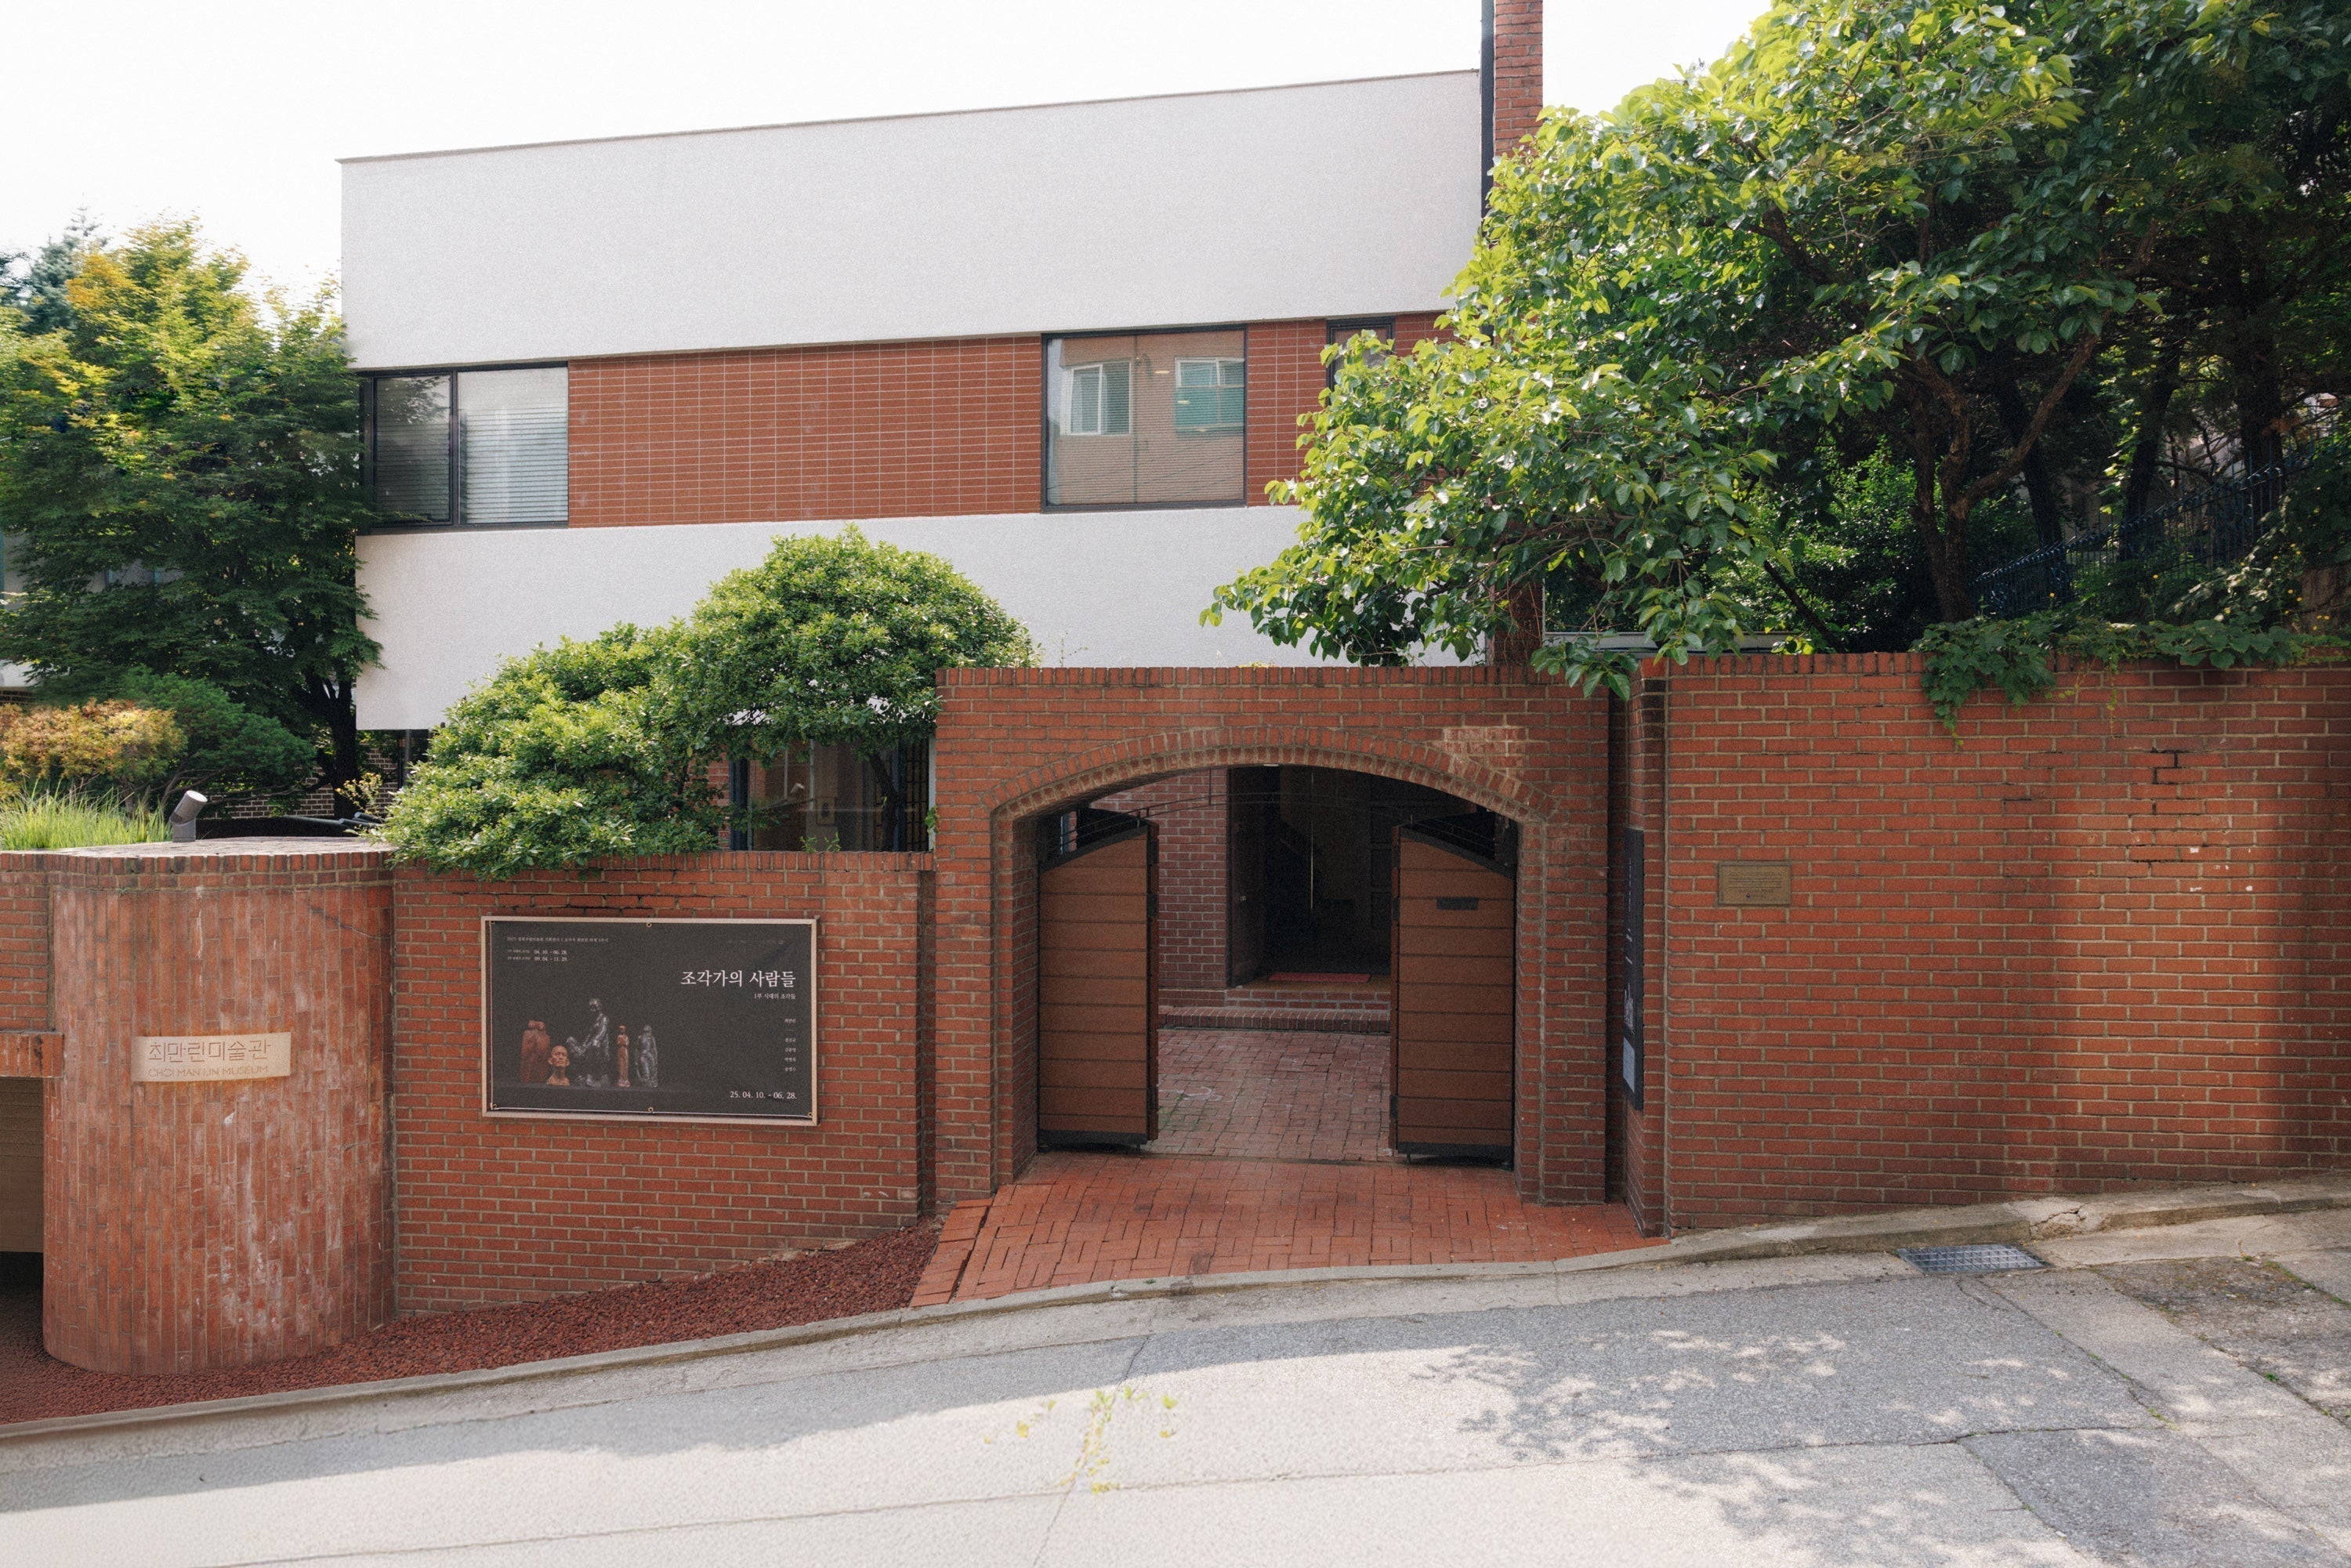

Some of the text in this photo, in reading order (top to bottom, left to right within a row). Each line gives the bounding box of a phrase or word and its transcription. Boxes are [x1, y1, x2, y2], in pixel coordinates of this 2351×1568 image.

[680, 969, 796, 987] 조각가의 사람들
[148, 1039, 271, 1063] 최만린미술관
[148, 1066, 267, 1077] CHOI MAN LIN MUSEUM
